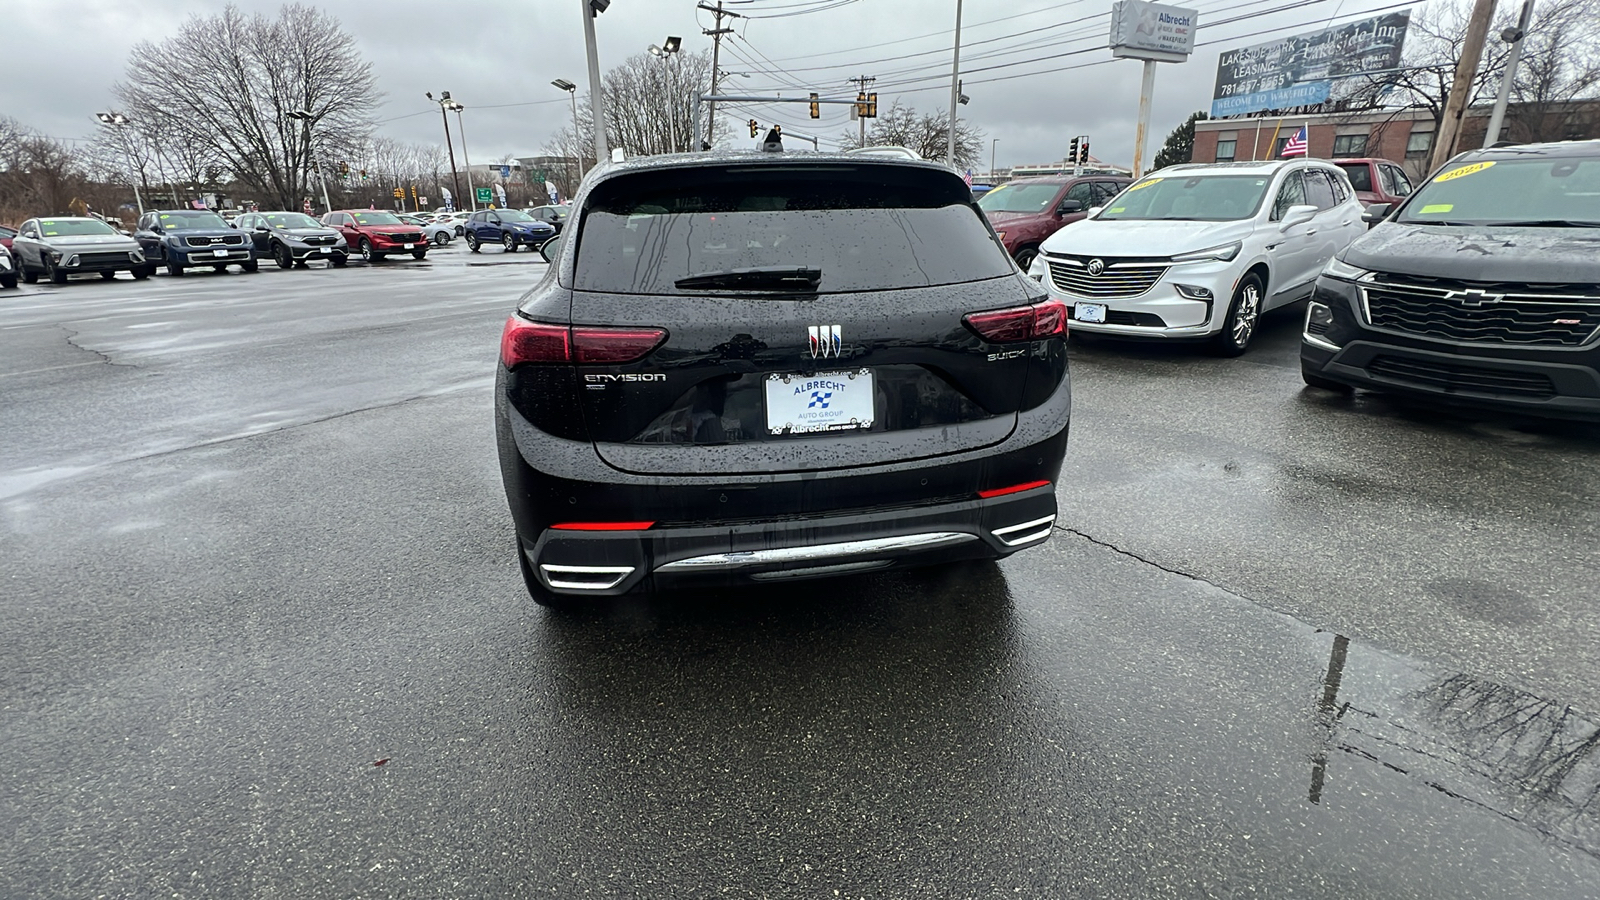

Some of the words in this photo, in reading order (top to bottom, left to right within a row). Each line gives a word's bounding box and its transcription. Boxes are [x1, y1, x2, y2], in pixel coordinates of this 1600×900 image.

[1158, 12, 1190, 26] Albrecht
[1162, 35, 1188, 44] WAKEFIELD
[1302, 28, 1366, 59] Lakeside
[1371, 20, 1397, 39] Inn
[1221, 47, 1267, 67] LAKESIDE
[1233, 60, 1275, 79] LEASING
[1217, 96, 1252, 109] WELCOME
[1256, 94, 1267, 104] TO
[1270, 86, 1316, 101] WAKEFIELD
[1445, 163, 1484, 180] 2024
[988, 350, 1026, 362] BUICK
[584, 373, 667, 383] ENVISION
[793, 380, 846, 396] ALBRECHT
[798, 411, 818, 420] AUTO
[819, 410, 844, 418] GROUP
[790, 423, 830, 434] Albrecht
